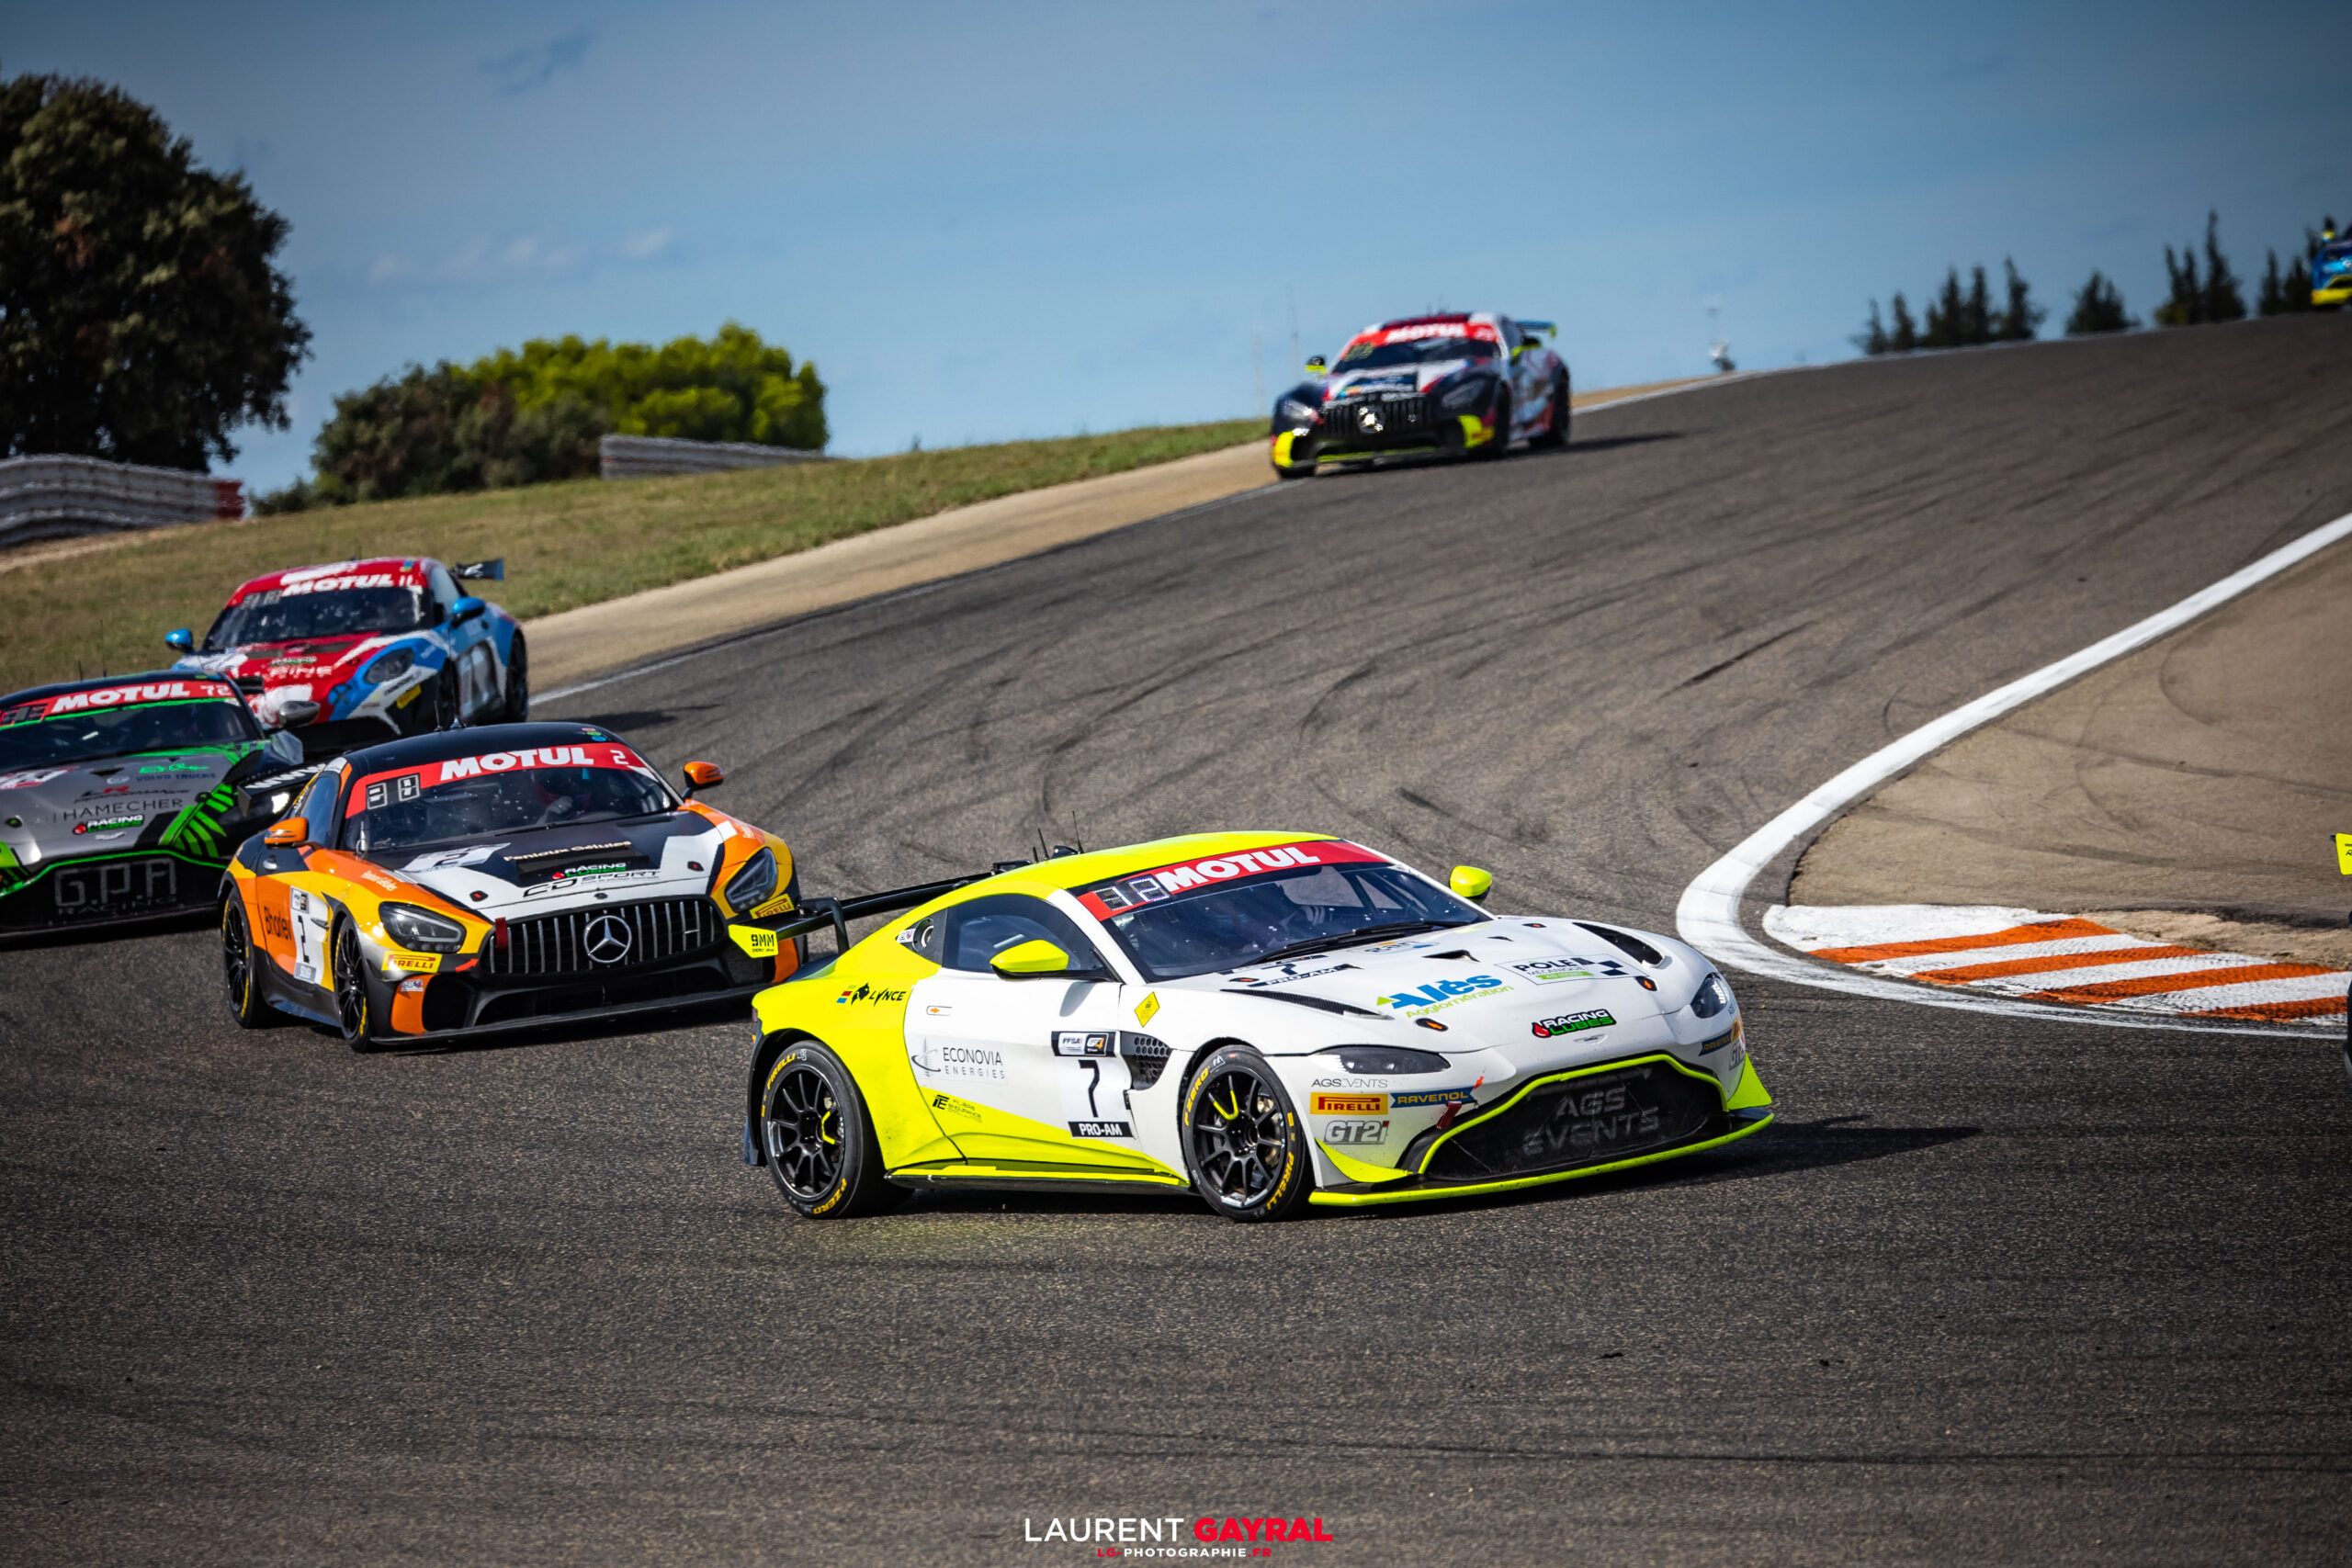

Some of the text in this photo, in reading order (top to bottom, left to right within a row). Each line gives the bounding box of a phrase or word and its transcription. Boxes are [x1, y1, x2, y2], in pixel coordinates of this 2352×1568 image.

[281, 573, 394, 597] MOTUL
[51, 682, 191, 714] MOTUL
[439, 747, 628, 781] MOTUL 2
[63, 797, 184, 821] HAMECHER
[87, 814, 144, 828] RACING
[564, 862, 627, 874] RACING
[582, 871, 662, 882] SPORT
[1155, 847, 1322, 894] MOTUL
[751, 933, 775, 947] 9MM
[868, 987, 908, 1008] LYNCE
[1389, 975, 1503, 1010] Alès
[1406, 985, 1515, 1019] Agglomération
[1542, 1010, 1610, 1028] RACING
[1549, 1016, 1614, 1035] LUBES
[943, 1047, 1003, 1066] ECONOVIA
[766, 1053, 797, 1090] PIRELLI
[944, 1066, 1005, 1079] ENERGIES
[1078, 1059, 1101, 1118] 7
[1317, 1090, 1469, 1111] PIRELLI RAVENOL
[1555, 1087, 1626, 1120] AGS
[1078, 1122, 1124, 1136] PRO-AM
[1323, 1120, 1390, 1145] GT2i
[1523, 1106, 1659, 1156] EVENTS
[1266, 1151, 1295, 1211] PIRELLI
